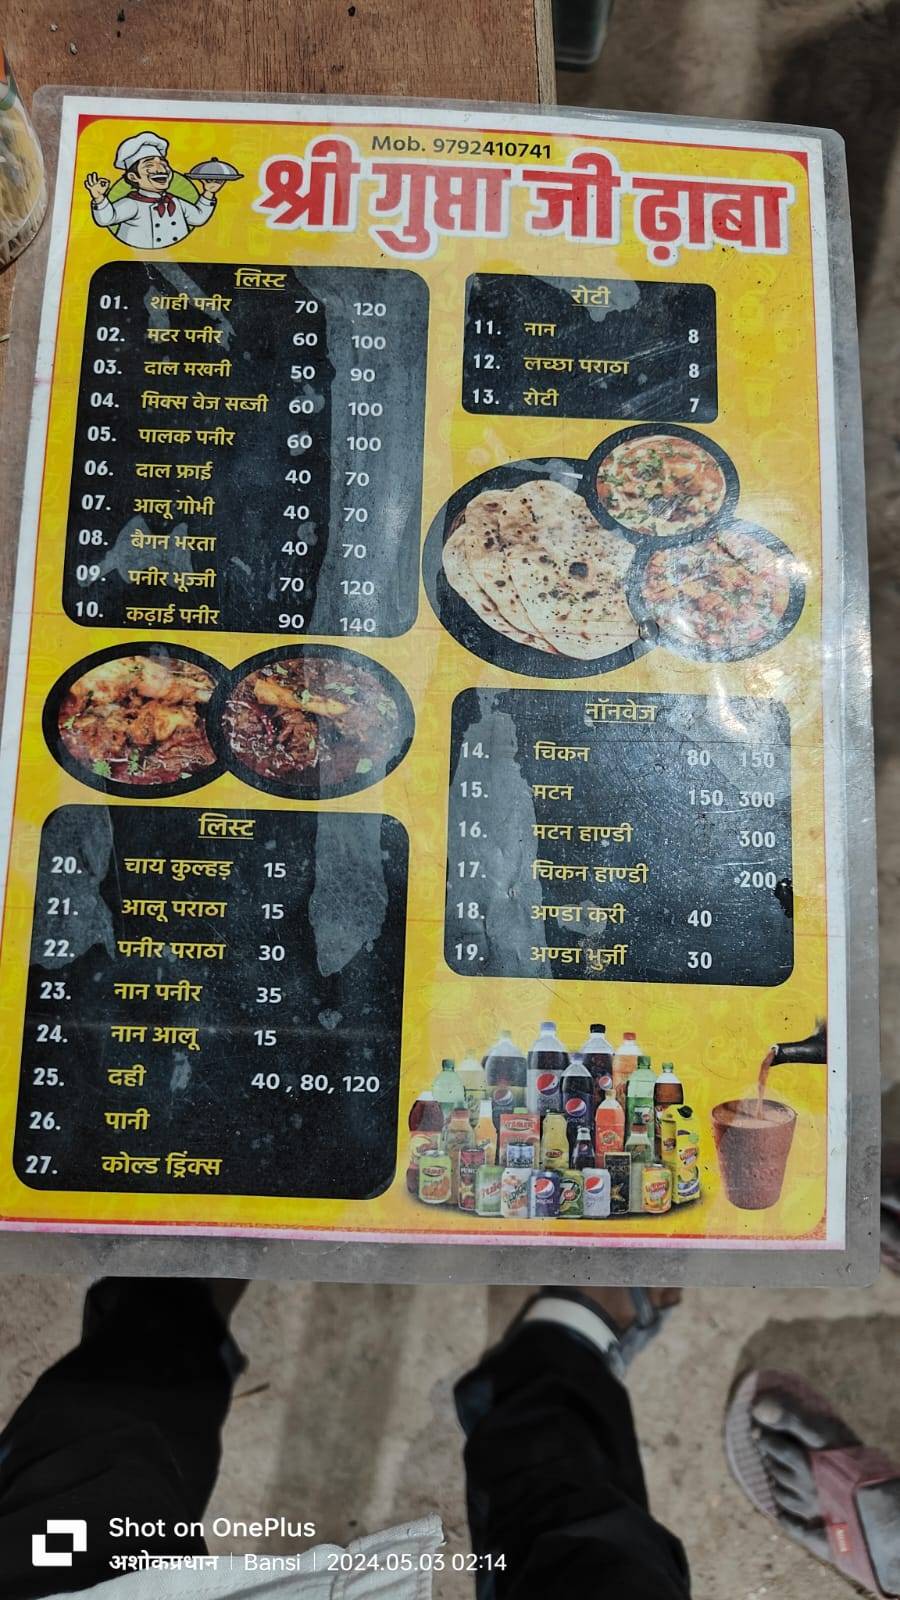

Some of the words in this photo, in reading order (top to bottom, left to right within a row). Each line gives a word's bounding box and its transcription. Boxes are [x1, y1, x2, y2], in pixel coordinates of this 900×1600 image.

[372, 136, 426, 151] Mob.
[434, 139, 551, 159] 9792410741
[257, 138, 361, 228] श्री
[372, 163, 511, 254] गुप्ता
[523, 152, 621, 239] जी
[632, 177, 788, 261] ढ़ाबा
[234, 268, 287, 288] लिस्ट
[100, 295, 128, 310] 01.
[150, 293, 190, 311] शाही
[194, 294, 232, 312] पनीर
[294, 300, 319, 314] 70
[353, 303, 387, 317] 120
[571, 285, 611, 305] रोटी
[96, 326, 125, 342] 02.
[147, 328, 180, 343] मटर
[184, 326, 224, 344] पनीर
[292, 332, 318, 347] 60
[352, 335, 386, 350] 100
[474, 320, 501, 335] 11.
[523, 322, 557, 337] नान
[688, 329, 699, 344] 8
[93, 359, 122, 375] 03.
[144, 361, 180, 376] दाल
[183, 359, 232, 377] मखनी
[290, 365, 315, 380] 50
[350, 368, 375, 382] 90
[473, 354, 501, 370] 12.
[523, 356, 574, 373] लच्छा
[578, 358, 630, 374] पराठा
[688, 363, 699, 379] 8
[90, 392, 120, 408] 04.
[141, 391, 189, 409] मिक्स
[192, 392, 221, 411] वेज
[224, 393, 269, 413] सब्जी
[288, 400, 314, 414] 60
[348, 402, 383, 417] 100
[472, 389, 500, 405] 13.
[523, 387, 559, 407] रोटी
[689, 398, 699, 413] 7
[87, 426, 116, 442] 05.
[138, 428, 192, 444] पालक
[196, 427, 236, 446] पनीर
[287, 434, 312, 449] 60
[346, 436, 382, 452] 100
[84, 460, 114, 476] 06.
[136, 463, 172, 479] दाल
[176, 461, 214, 480] फ्राई
[284, 469, 311, 485] 40
[345, 471, 370, 487] 70
[81, 494, 111, 511] 07.
[133, 499, 174, 520] आलू
[176, 496, 215, 516] गोभी
[283, 505, 310, 520] 40
[343, 507, 368, 523] 70
[78, 529, 109, 546] 08.
[174, 536, 217, 551] भरता
[281, 541, 308, 556] 40
[342, 543, 367, 559] 70
[76, 564, 106, 581] 09.
[128, 566, 169, 586] पनीर
[279, 577, 304, 592] 70
[340, 580, 375, 596] 120
[75, 601, 104, 618] 10.
[179, 604, 220, 625] पनीर
[278, 613, 304, 629] 90
[339, 617, 377, 633] 140
[585, 698, 658, 721] नॉनवेज
[461, 743, 489, 759] 14.
[533, 741, 590, 762] चिकन
[687, 750, 711, 766] 80
[740, 751, 775, 768] 150
[460, 782, 489, 798] 15.
[532, 784, 574, 801] मटन
[689, 789, 723, 806] 150
[739, 791, 775, 808] 300
[198, 813, 255, 837] लिस्ट
[459, 821, 487, 838] 16.
[531, 824, 574, 840] मटन
[579, 822, 634, 842] हाण्डी
[739, 831, 776, 848] 300
[51, 857, 82, 874] 20.
[124, 858, 166, 875] चाय
[170, 859, 233, 881] कुल्हड़
[263, 862, 286, 878] 15
[457, 861, 487, 878] 17.
[530, 859, 589, 881] चिकन
[594, 863, 649, 883] हाण्डी
[740, 871, 777, 888] 200
[47, 898, 78, 916] 21.
[121, 899, 168, 923] आलू
[171, 900, 227, 918] पराठा
[261, 904, 284, 919] 15
[456, 902, 485, 919] 18.
[530, 905, 582, 922] अण्डा
[587, 903, 626, 924] करी
[687, 910, 712, 927] 40
[43, 940, 75, 957] 22.
[117, 937, 164, 958] पनीर
[170, 941, 226, 960] पराठा
[259, 945, 285, 961] 30
[455, 944, 484, 961] 19.
[530, 946, 582, 964] अण्डा
[687, 952, 713, 969] 30
[40, 981, 71, 1000] 23.
[114, 983, 150, 1000] नान
[155, 980, 202, 1002] पनीर
[256, 987, 282, 1003] 35
[36, 1024, 68, 1043] 24.
[111, 1025, 146, 1043] नान
[152, 1025, 201, 1051] आलू
[254, 1030, 277, 1046] 15
[33, 1068, 65, 1086] 25.
[107, 1064, 147, 1087] दही
[251, 1073, 280, 1089] 40
[342, 1076, 380, 1092] 120
[29, 1111, 61, 1131] 26.
[105, 1108, 150, 1130] पानी
[25, 1155, 58, 1174] 27.
[101, 1151, 160, 1174] कोल्ड
[165, 1150, 223, 1178] ड्रिंक्स
